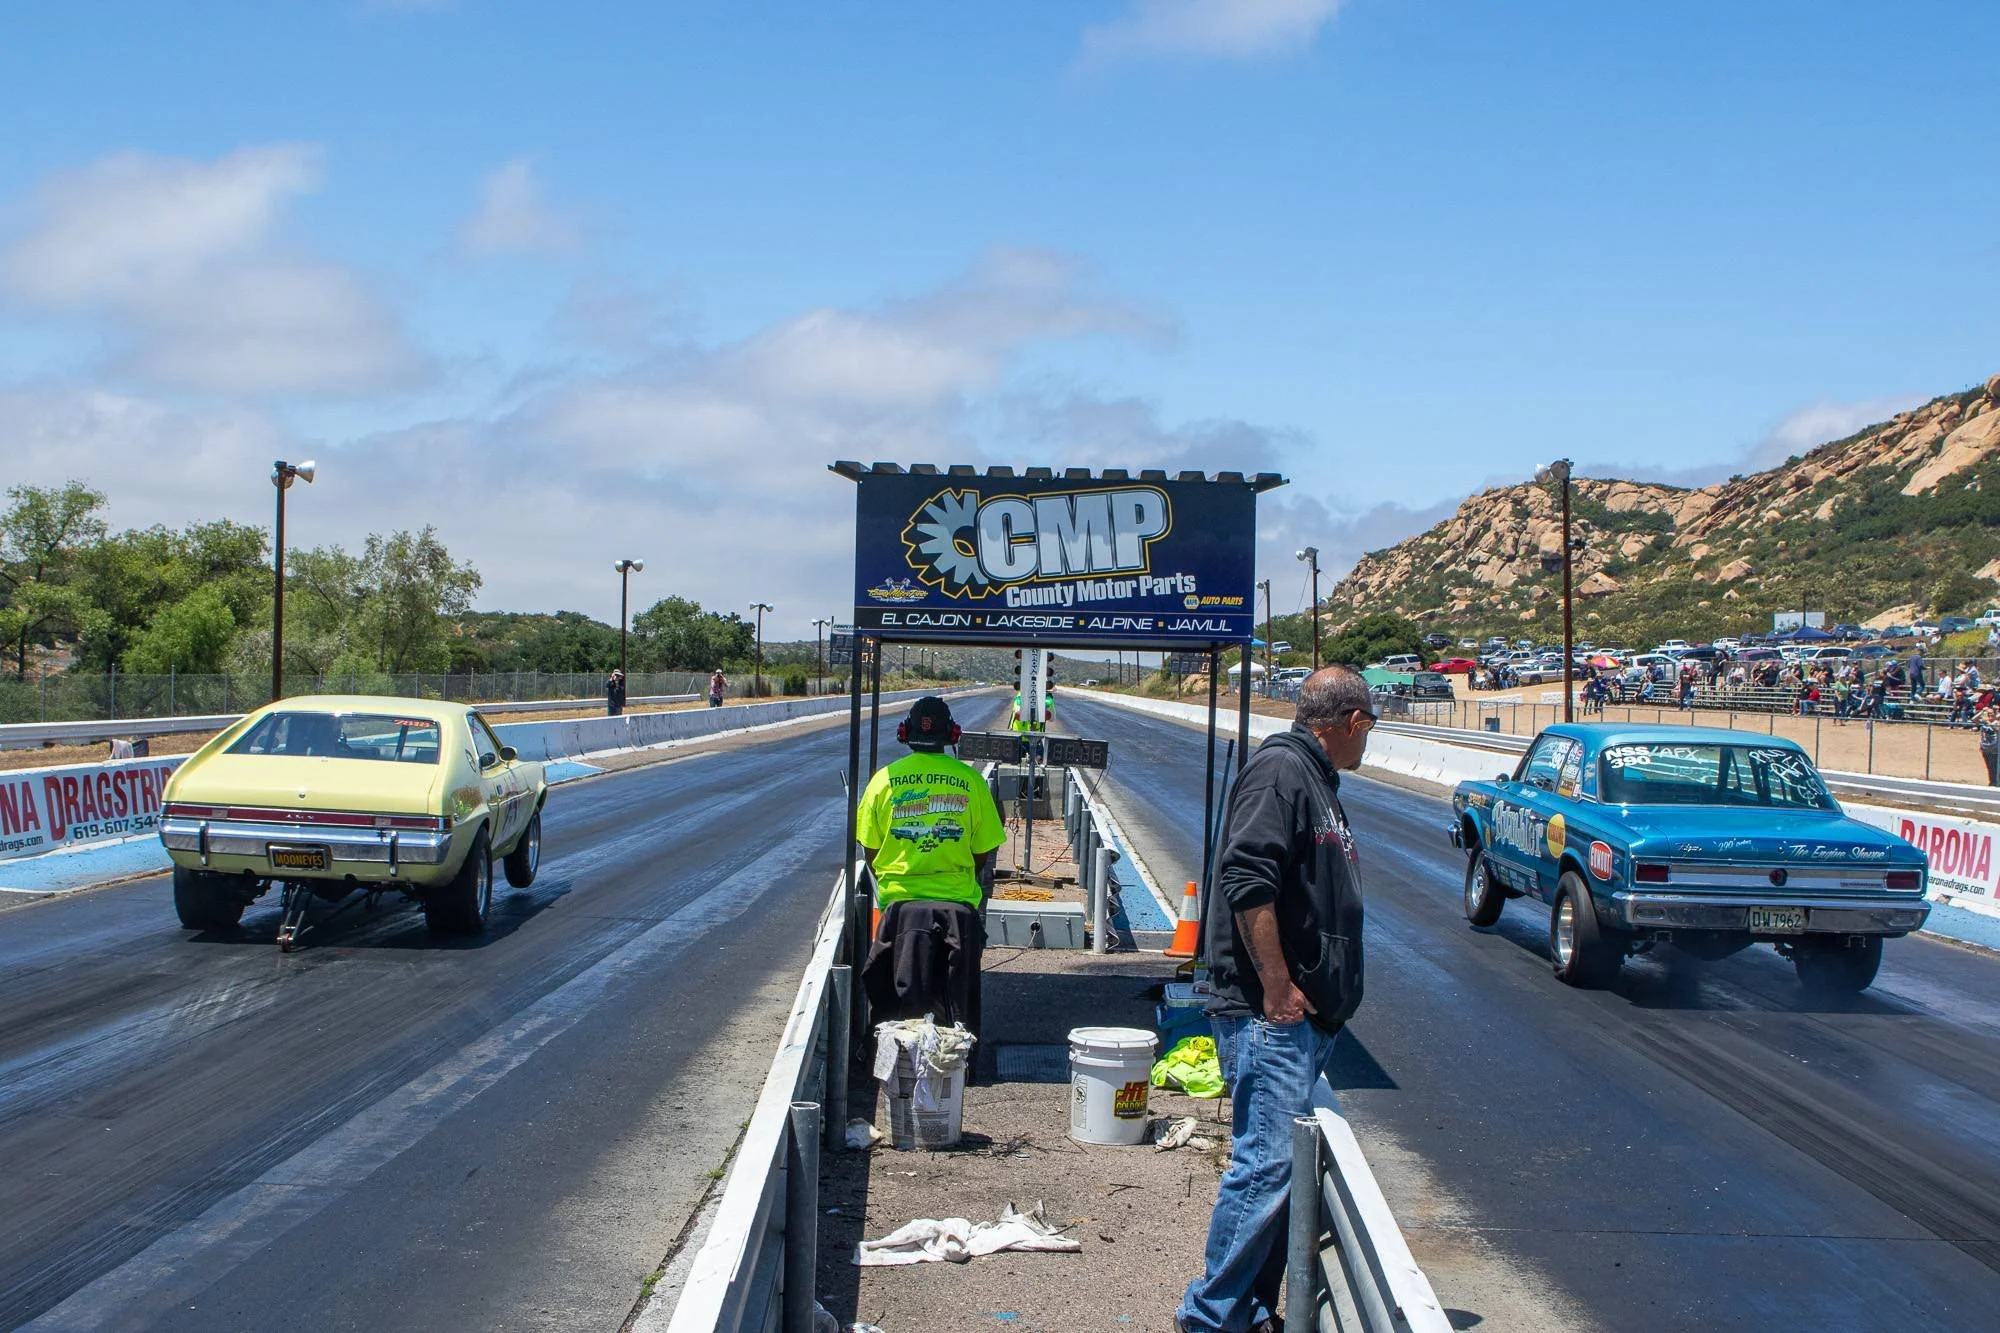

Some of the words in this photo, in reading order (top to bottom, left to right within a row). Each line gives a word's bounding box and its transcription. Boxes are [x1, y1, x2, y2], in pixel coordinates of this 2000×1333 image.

[977, 489, 1168, 582] CMP
[1006, 582, 1074, 608] County
[1077, 577, 1138, 602] Motor
[1139, 572, 1196, 597] Parts
[1200, 596, 1221, 605] AUTO
[1221, 596, 1244, 605] PARTS
[881, 612, 903, 625] EL
[906, 613, 971, 627] CAJON
[985, 614, 1075, 629] LAKESIDE
[1088, 616, 1153, 630] ALPINE
[1168, 618, 1232, 632] JAMUL
[1610, 756, 1651, 769] 390
[888, 773, 923, 788] TRACK
[926, 773, 971, 792] OFFICIAL
[275, 854, 322, 866] MOONEYES
[1789, 845, 1809, 857] The
[1811, 846, 1847, 860] Engine
[1928, 876, 1985, 895] aronadrags.com
[1772, 913, 1801, 928] 7962
